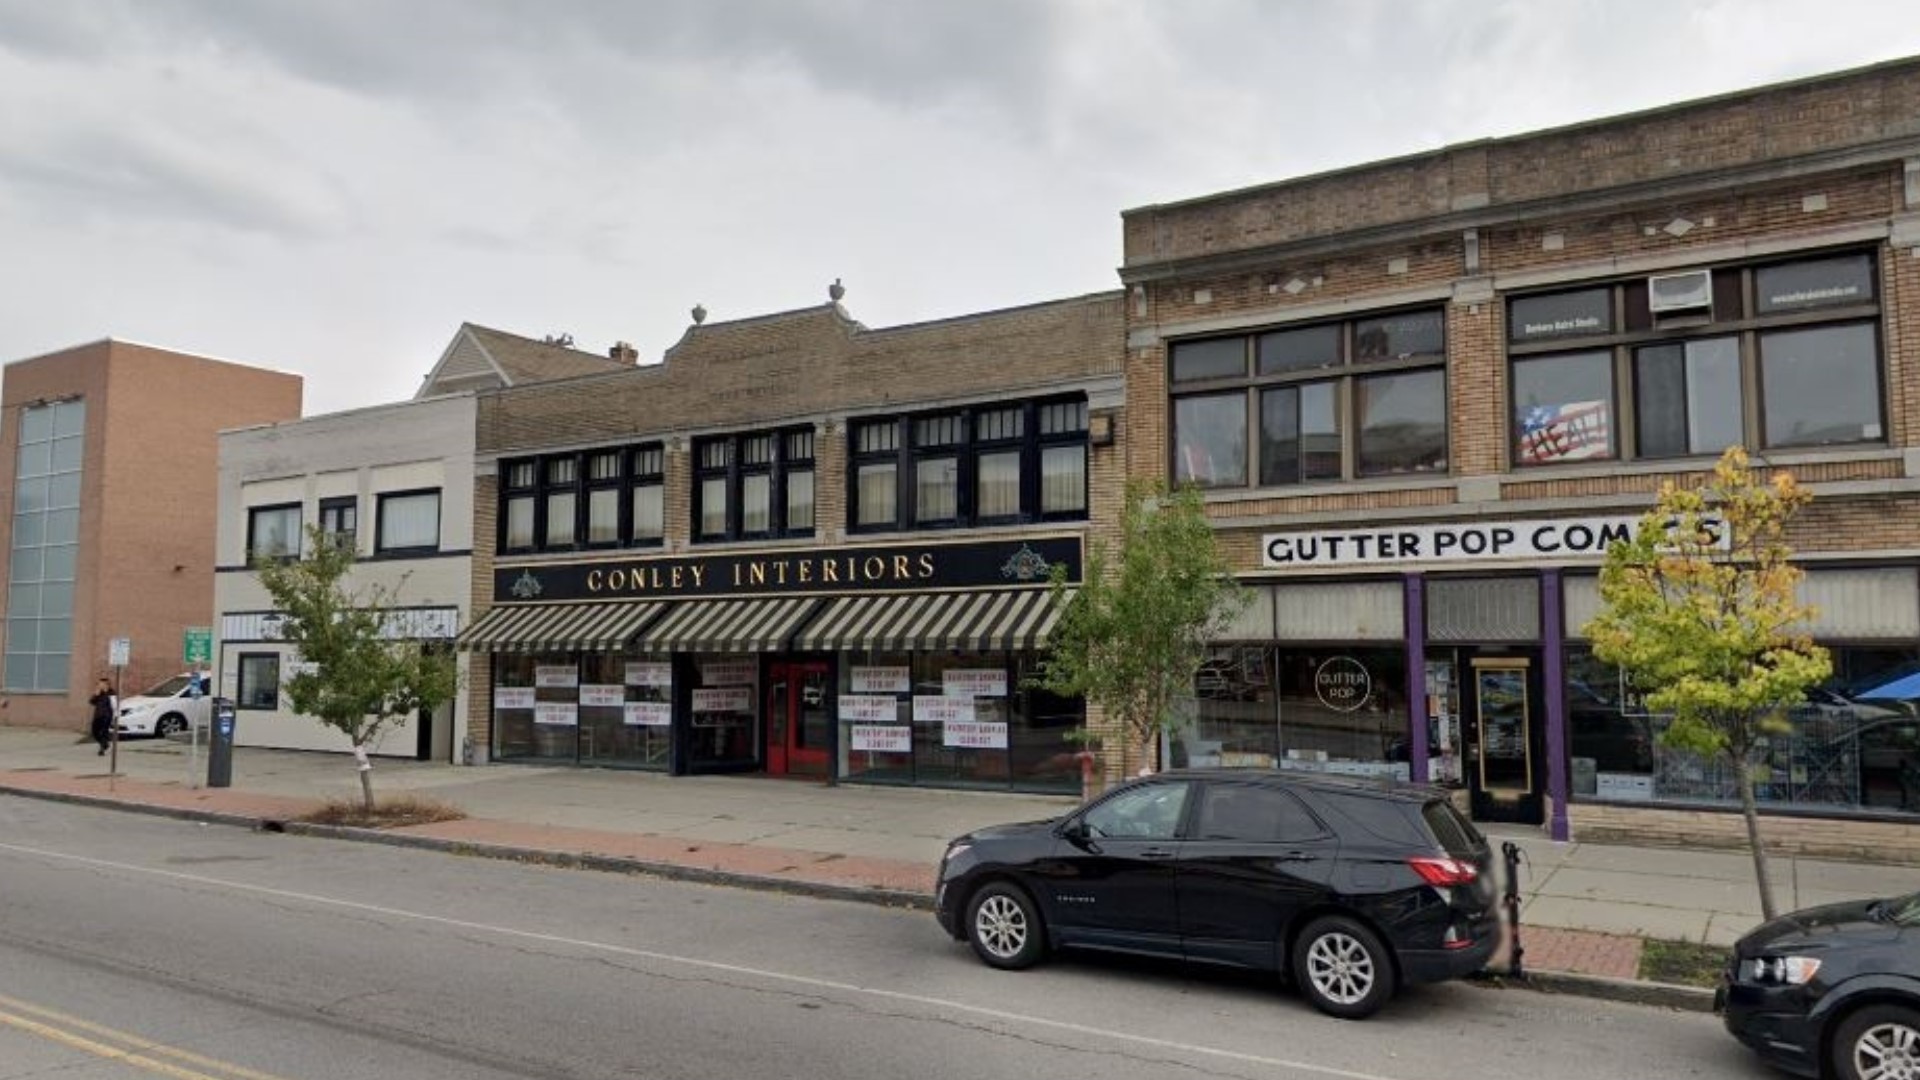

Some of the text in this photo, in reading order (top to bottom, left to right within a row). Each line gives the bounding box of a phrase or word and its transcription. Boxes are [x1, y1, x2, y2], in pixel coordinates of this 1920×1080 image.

[1267, 519, 1722, 562] GUTTER POP COMS
[587, 553, 935, 591] CONLEY INTERIORS
[1319, 672, 1365, 685] GUTTER
[1329, 687, 1356, 699] POP
